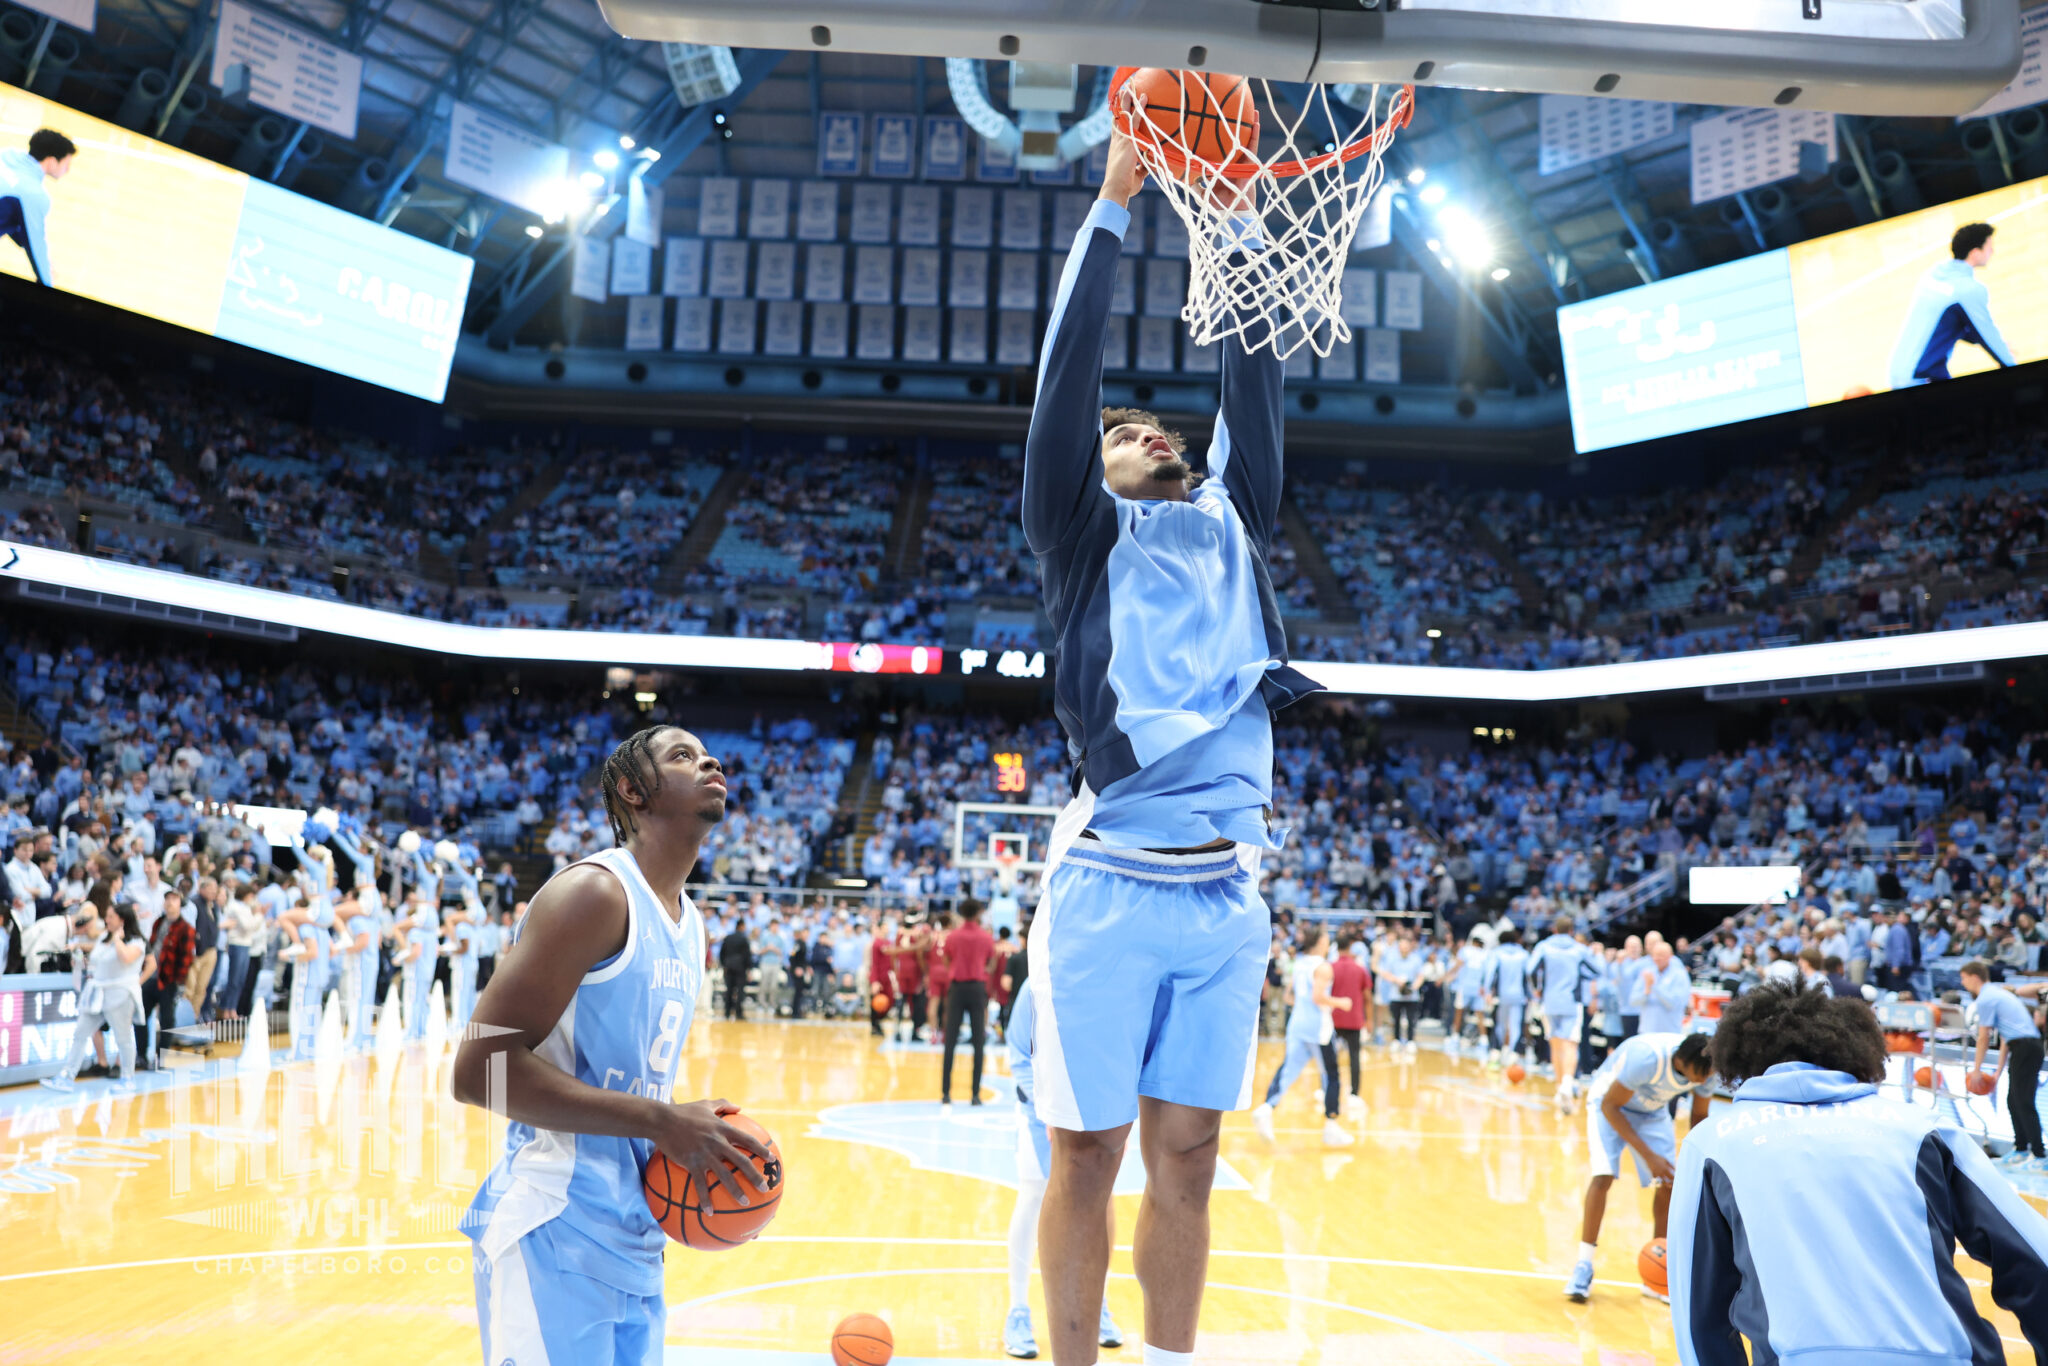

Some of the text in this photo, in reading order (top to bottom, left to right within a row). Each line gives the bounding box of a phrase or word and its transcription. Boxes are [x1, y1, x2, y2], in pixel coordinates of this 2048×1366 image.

[997, 767, 1026, 792] 30
[651, 957, 698, 1001] NORTH
[648, 1000, 684, 1073] 8
[1716, 1102, 1904, 1138] CAROLINA
